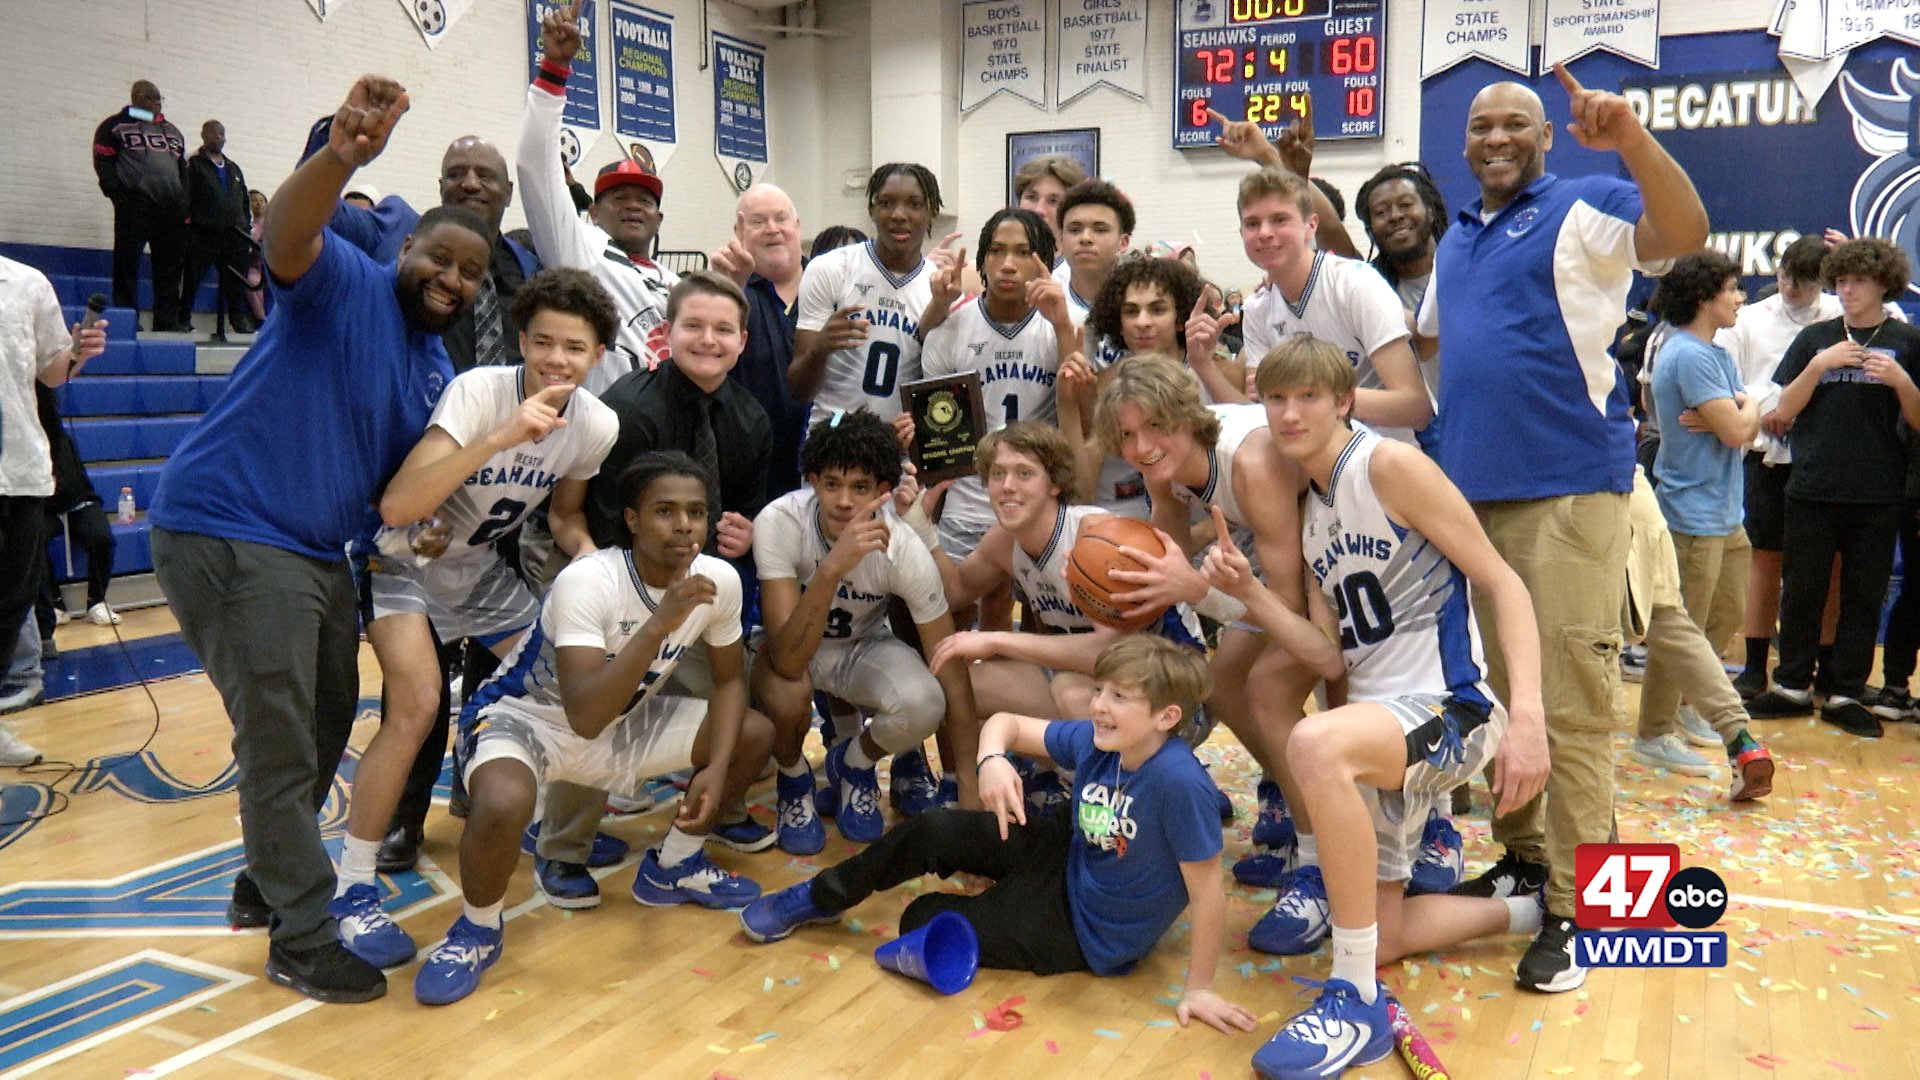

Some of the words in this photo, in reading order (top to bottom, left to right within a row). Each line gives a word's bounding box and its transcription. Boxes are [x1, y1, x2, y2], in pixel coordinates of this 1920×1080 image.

[988, 6, 1020, 20] BOYS
[1063, 10, 1142, 29] BASKETBALL
[1456, 11, 1500, 26] STATE
[1553, 8, 1655, 27] SPORTSMANSHIP
[615, 17, 669, 50] FOOTBALL
[967, 20, 1041, 38] BASKETBALL
[1090, 28, 1116, 41] 1977
[1324, 17, 1374, 36] GUEST
[1446, 27, 1508, 44] CHAMPS
[1583, 24, 1624, 36] AWARD
[992, 38, 1018, 49] 1970
[1183, 27, 1257, 48] SEAHAWKS
[1260, 33, 1296, 46] PERIOD
[720, 47, 760, 71] VOLLEY
[988, 53, 1022, 67] STATE
[1085, 44, 1121, 58] STATE
[1331, 37, 1375, 74] 60
[1076, 59, 1128, 75] FINALIST
[1197, 48, 1235, 83] 72
[1269, 49, 1287, 74] 4
[729, 65, 756, 84] BALL
[980, 68, 1029, 83] CHAMPS
[1344, 75, 1377, 88] FOULS
[1181, 87, 1212, 100] FOULS
[1244, 83, 1282, 96] PLAYER
[1285, 81, 1311, 92] FOUL
[1247, 95, 1280, 123] 22
[1290, 95, 1306, 118] 4
[1348, 88, 1374, 117] 10
[1192, 99, 1208, 127] 6
[863, 341, 900, 397] 0
[1001, 394, 1018, 424] 1
[467, 497, 527, 546] 2
